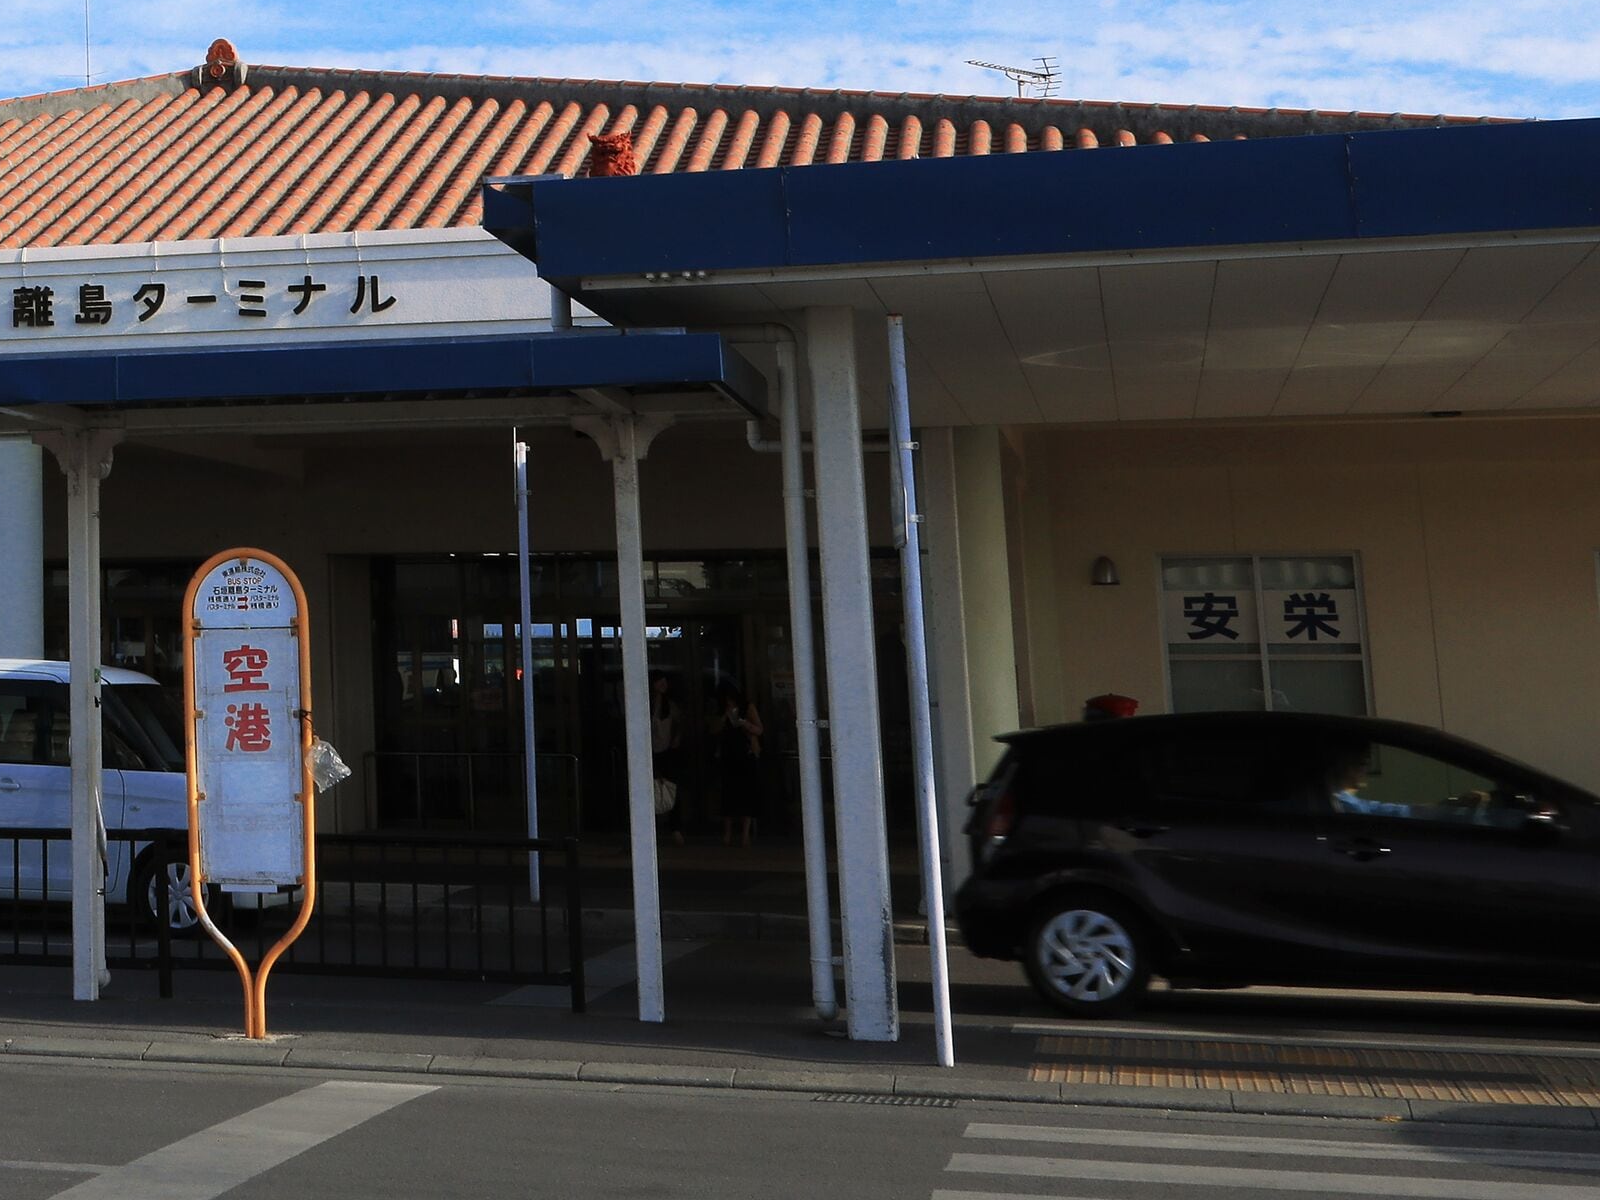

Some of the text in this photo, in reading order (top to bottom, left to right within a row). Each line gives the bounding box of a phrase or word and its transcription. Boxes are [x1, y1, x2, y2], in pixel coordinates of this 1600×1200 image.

[213, 585, 278, 595] 石垣離島ターミナル
[243, 577, 262, 585] STOP
[1183, 592, 1341, 641] 安栄
[224, 645, 272, 752] 空港
